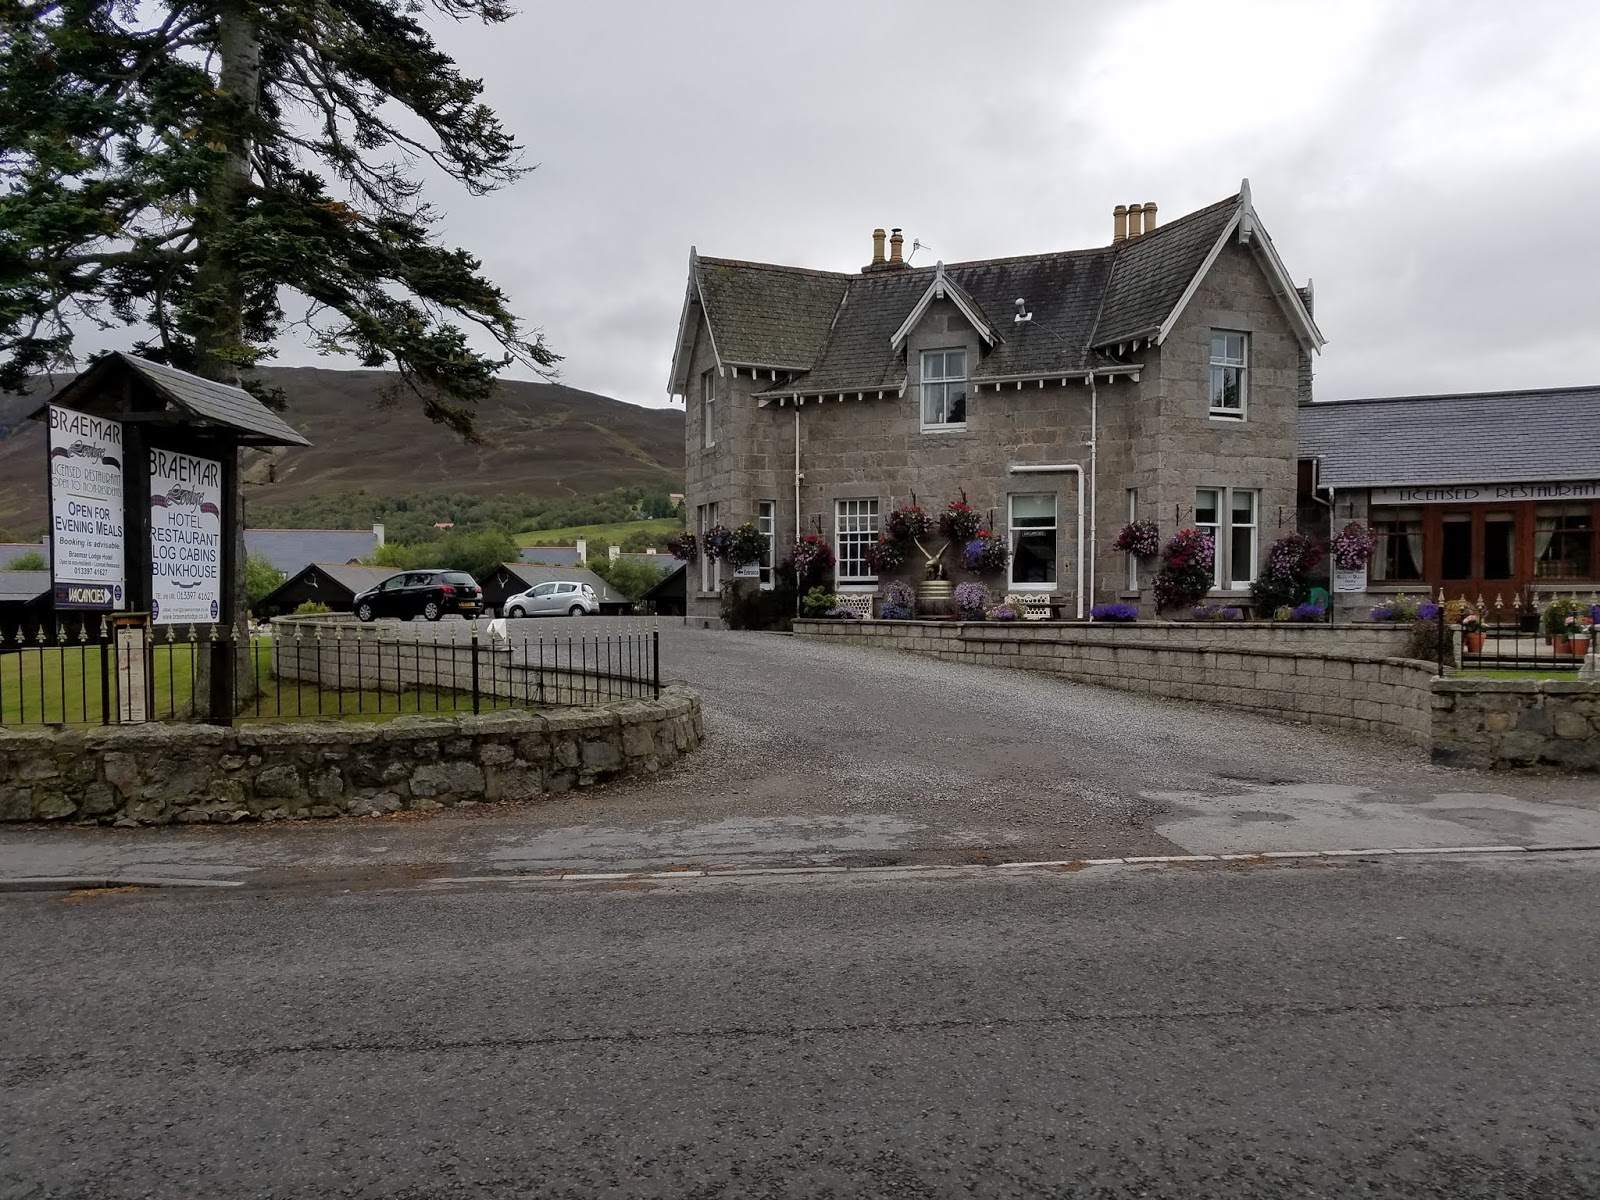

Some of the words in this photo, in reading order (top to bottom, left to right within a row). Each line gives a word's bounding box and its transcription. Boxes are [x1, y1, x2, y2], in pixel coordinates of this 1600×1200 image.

[50, 408, 121, 444] BRAEMAR
[67, 440, 106, 465] Lodge
[52, 462, 81, 479] LICENSED
[84, 468, 121, 486] RESTAURANT
[150, 449, 219, 488] BRAEMAR
[52, 477, 69, 489] OPEN
[71, 479, 81, 490] TO
[1400, 488, 1479, 500] LICENSED
[1496, 484, 1600, 499] RESTAURAN
[165, 483, 205, 513] Lodge
[68, 501, 93, 518] OPEN
[94, 507, 110, 520] FOR
[55, 515, 94, 534] EVENING
[95, 520, 123, 537] MEALS
[168, 511, 203, 529] HOTEL
[59, 536, 85, 548] Booking
[86, 539, 92, 547] is
[150, 527, 219, 546] RESTAURANT
[69, 550, 88, 559] Braemar
[88, 551, 101, 560] Lodge
[153, 545, 176, 559] LOG
[179, 547, 216, 562] CABINS
[74, 567, 92, 575] 013397
[152, 562, 217, 578] BUNKHOUSE
[68, 587, 105, 603] VACANCIES
[177, 591, 196, 600] 013397
[198, 592, 214, 601] 41627
